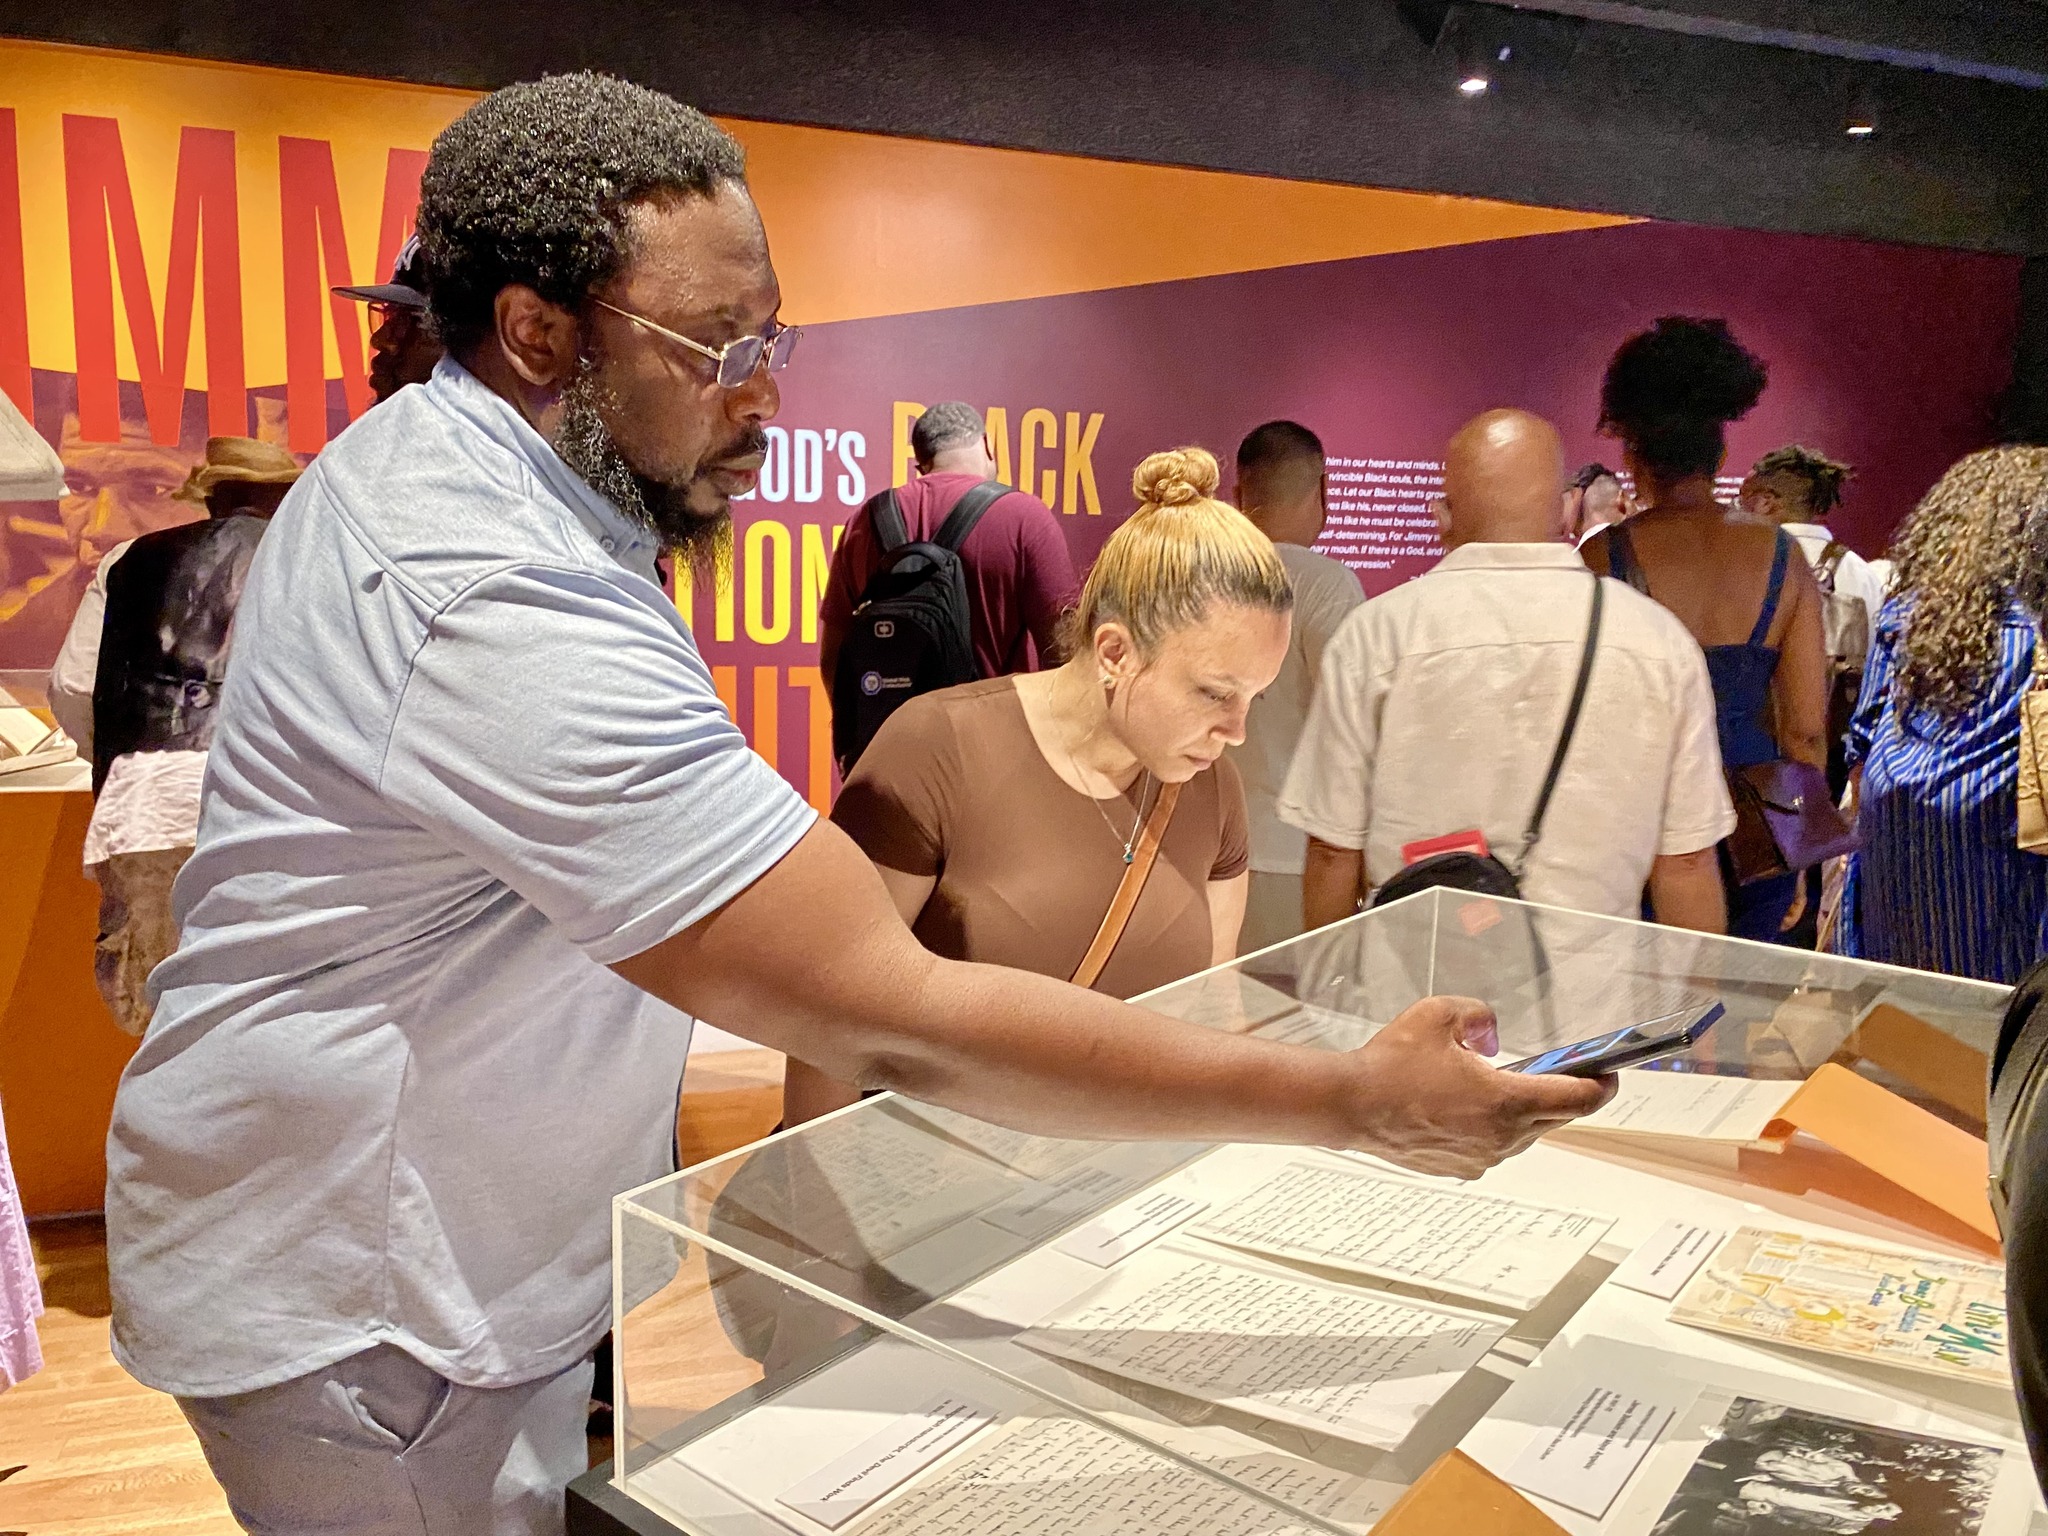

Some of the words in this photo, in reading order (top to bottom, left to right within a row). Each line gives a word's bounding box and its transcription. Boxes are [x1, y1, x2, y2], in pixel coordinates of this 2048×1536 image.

[733, 427, 867, 505] OD'S
[1325, 457, 1342, 466] him
[1342, 457, 1351, 467] in
[1352, 459, 1368, 467] our
[1368, 458, 1395, 469] hearts
[1396, 460, 1413, 469] and
[1412, 461, 1440, 470] minds.
[1364, 472, 1387, 483] Black
[1414, 475, 1428, 484] the
[1343, 486, 1357, 497] Let
[1358, 488, 1373, 497] our
[1373, 487, 1397, 498] Black
[1398, 489, 1425, 499] hearts
[1340, 501, 1356, 511] like
[1372, 503, 1397, 512] never
[1397, 502, 1426, 513] closed.
[1326, 515, 1343, 525] him
[1343, 515, 1359, 525] like
[1359, 516, 1371, 526] he
[1371, 517, 1393, 526] must
[1393, 516, 1405, 527] be
[1388, 531, 1403, 541] For
[1404, 531, 1433, 544] Jimmy
[1330, 545, 1359, 554] mouth.
[1360, 545, 1368, 554] If
[1368, 545, 1390, 555] there
[1390, 545, 1399, 555] is
[1399, 547, 1405, 555] a
[1406, 546, 1425, 556] God,
[1426, 547, 1443, 556] and
[879, 1454, 896, 1463] The
[861, 1462, 881, 1476] Devil
[841, 1474, 863, 1488] Finds
[820, 1488, 843, 1502] Work
